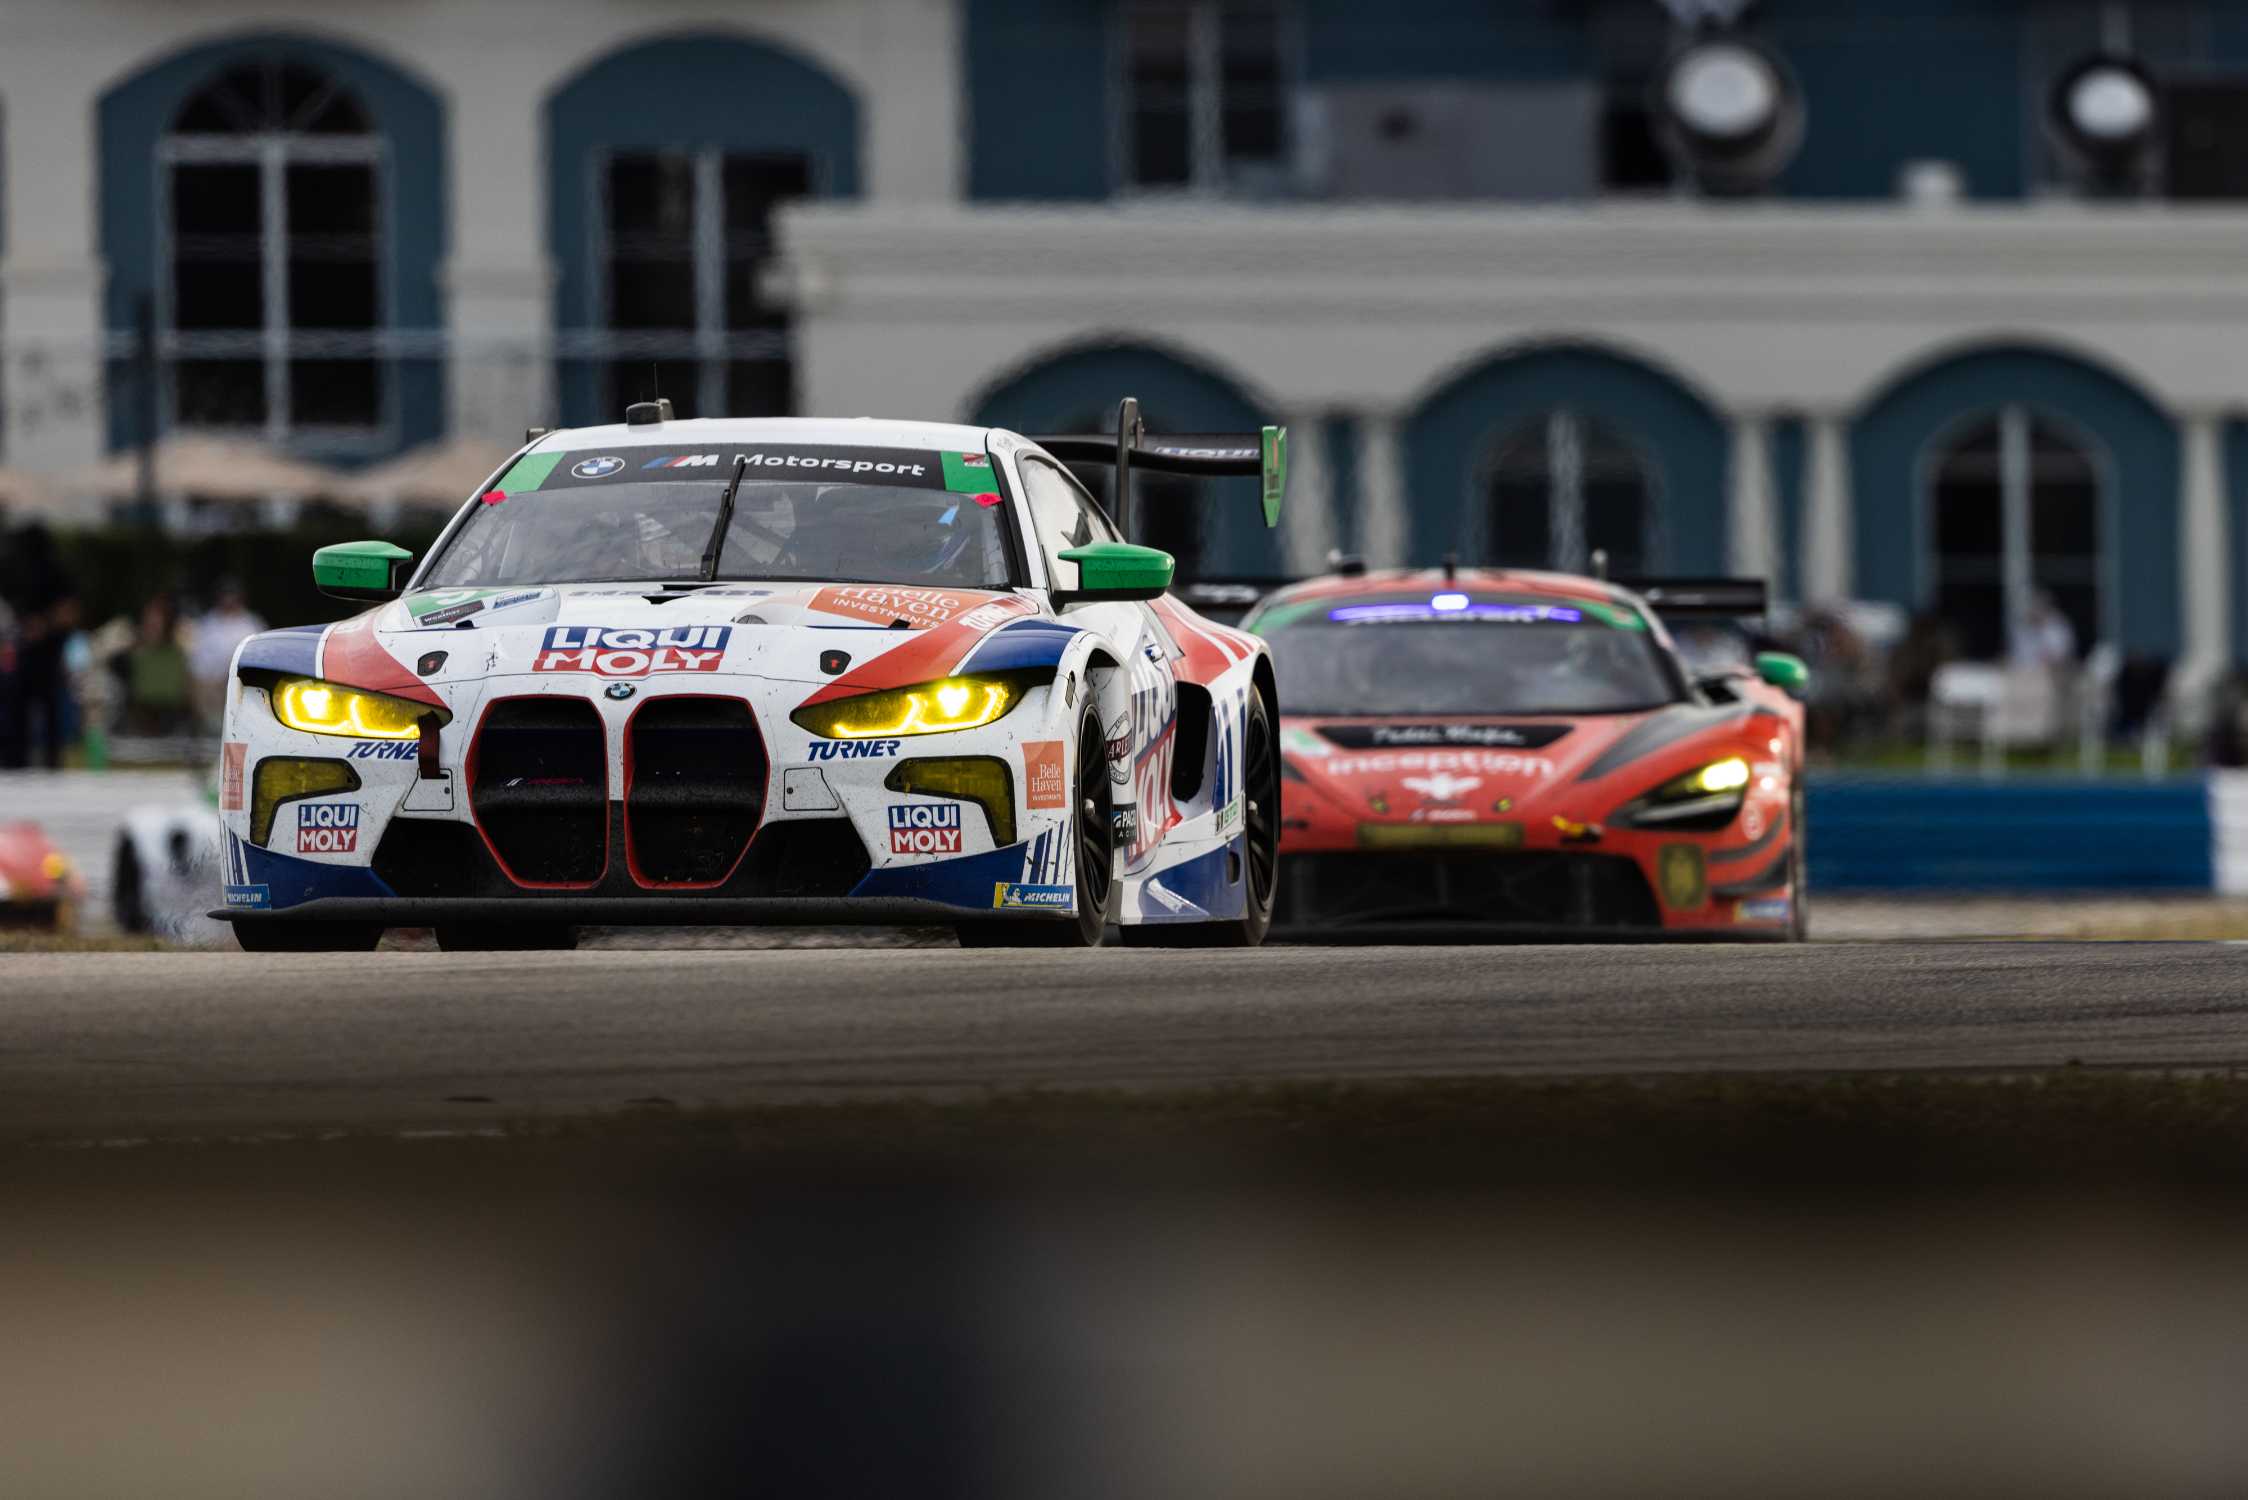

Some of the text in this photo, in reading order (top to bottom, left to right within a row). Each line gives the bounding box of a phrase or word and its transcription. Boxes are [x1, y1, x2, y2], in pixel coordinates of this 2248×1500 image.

[732, 453, 926, 477] Motorsport
[879, 587, 960, 609] elle
[832, 597, 940, 628] INVESTMENTS
[550, 627, 724, 649] LIQUI
[542, 649, 721, 675] MOLY
[346, 741, 419, 761] TURNE
[807, 740, 901, 762] TURNER
[1039, 763, 1061, 779] Belle
[1031, 777, 1062, 792] Haven
[300, 805, 357, 828] LIQUI
[891, 805, 958, 829] LIQUI
[299, 829, 355, 851] MOLY
[893, 830, 960, 852] MOLY
[1023, 892, 1071, 903] MICHELIN
